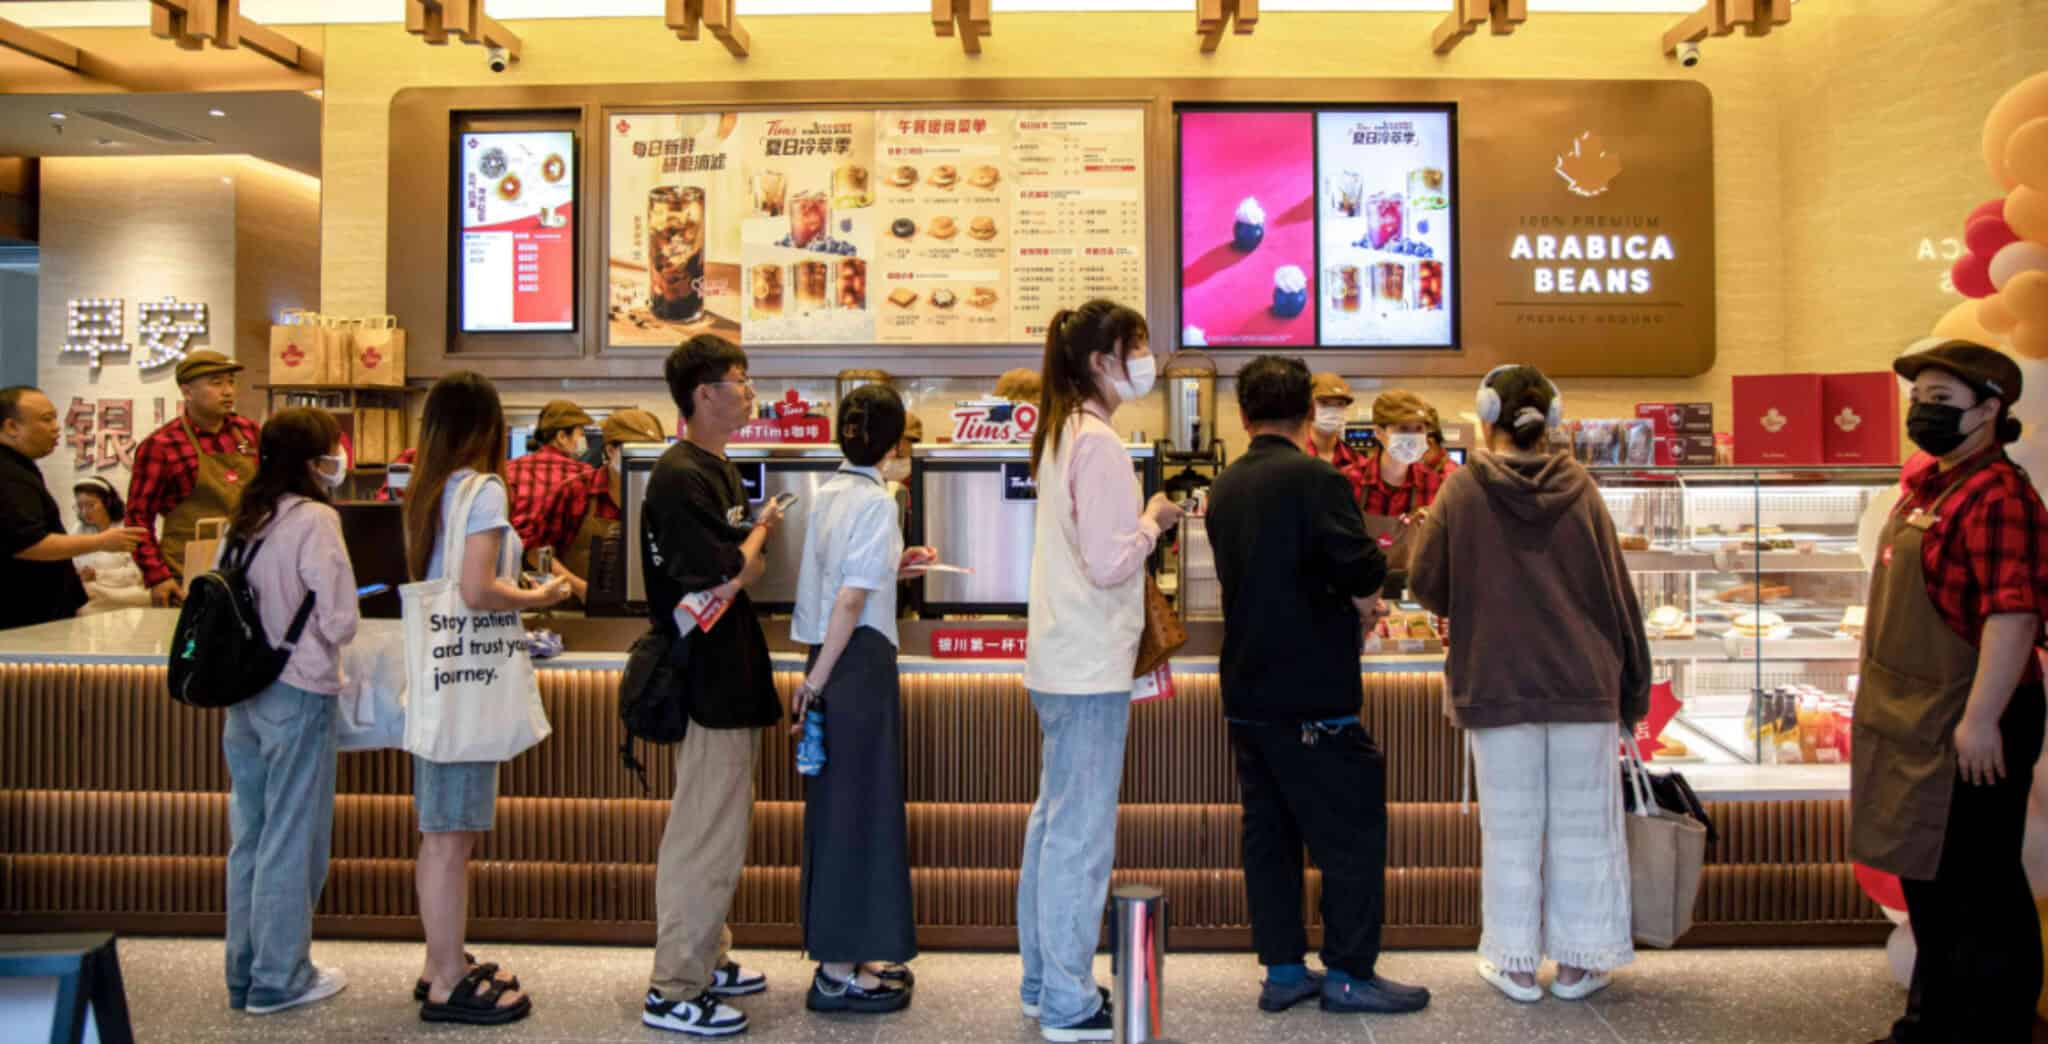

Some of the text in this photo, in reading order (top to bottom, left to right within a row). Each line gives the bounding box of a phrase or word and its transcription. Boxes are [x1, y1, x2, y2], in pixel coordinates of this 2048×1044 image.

[1573, 215, 1661, 228] PREMIUM
[1509, 234, 1675, 261] ARABICA
[1533, 267, 1652, 294] BEANS
[61, 295, 209, 372] 早安
[954, 410, 1011, 440] Tims
[429, 611, 518, 635] Stay patient
[470, 637, 504, 655] trust
